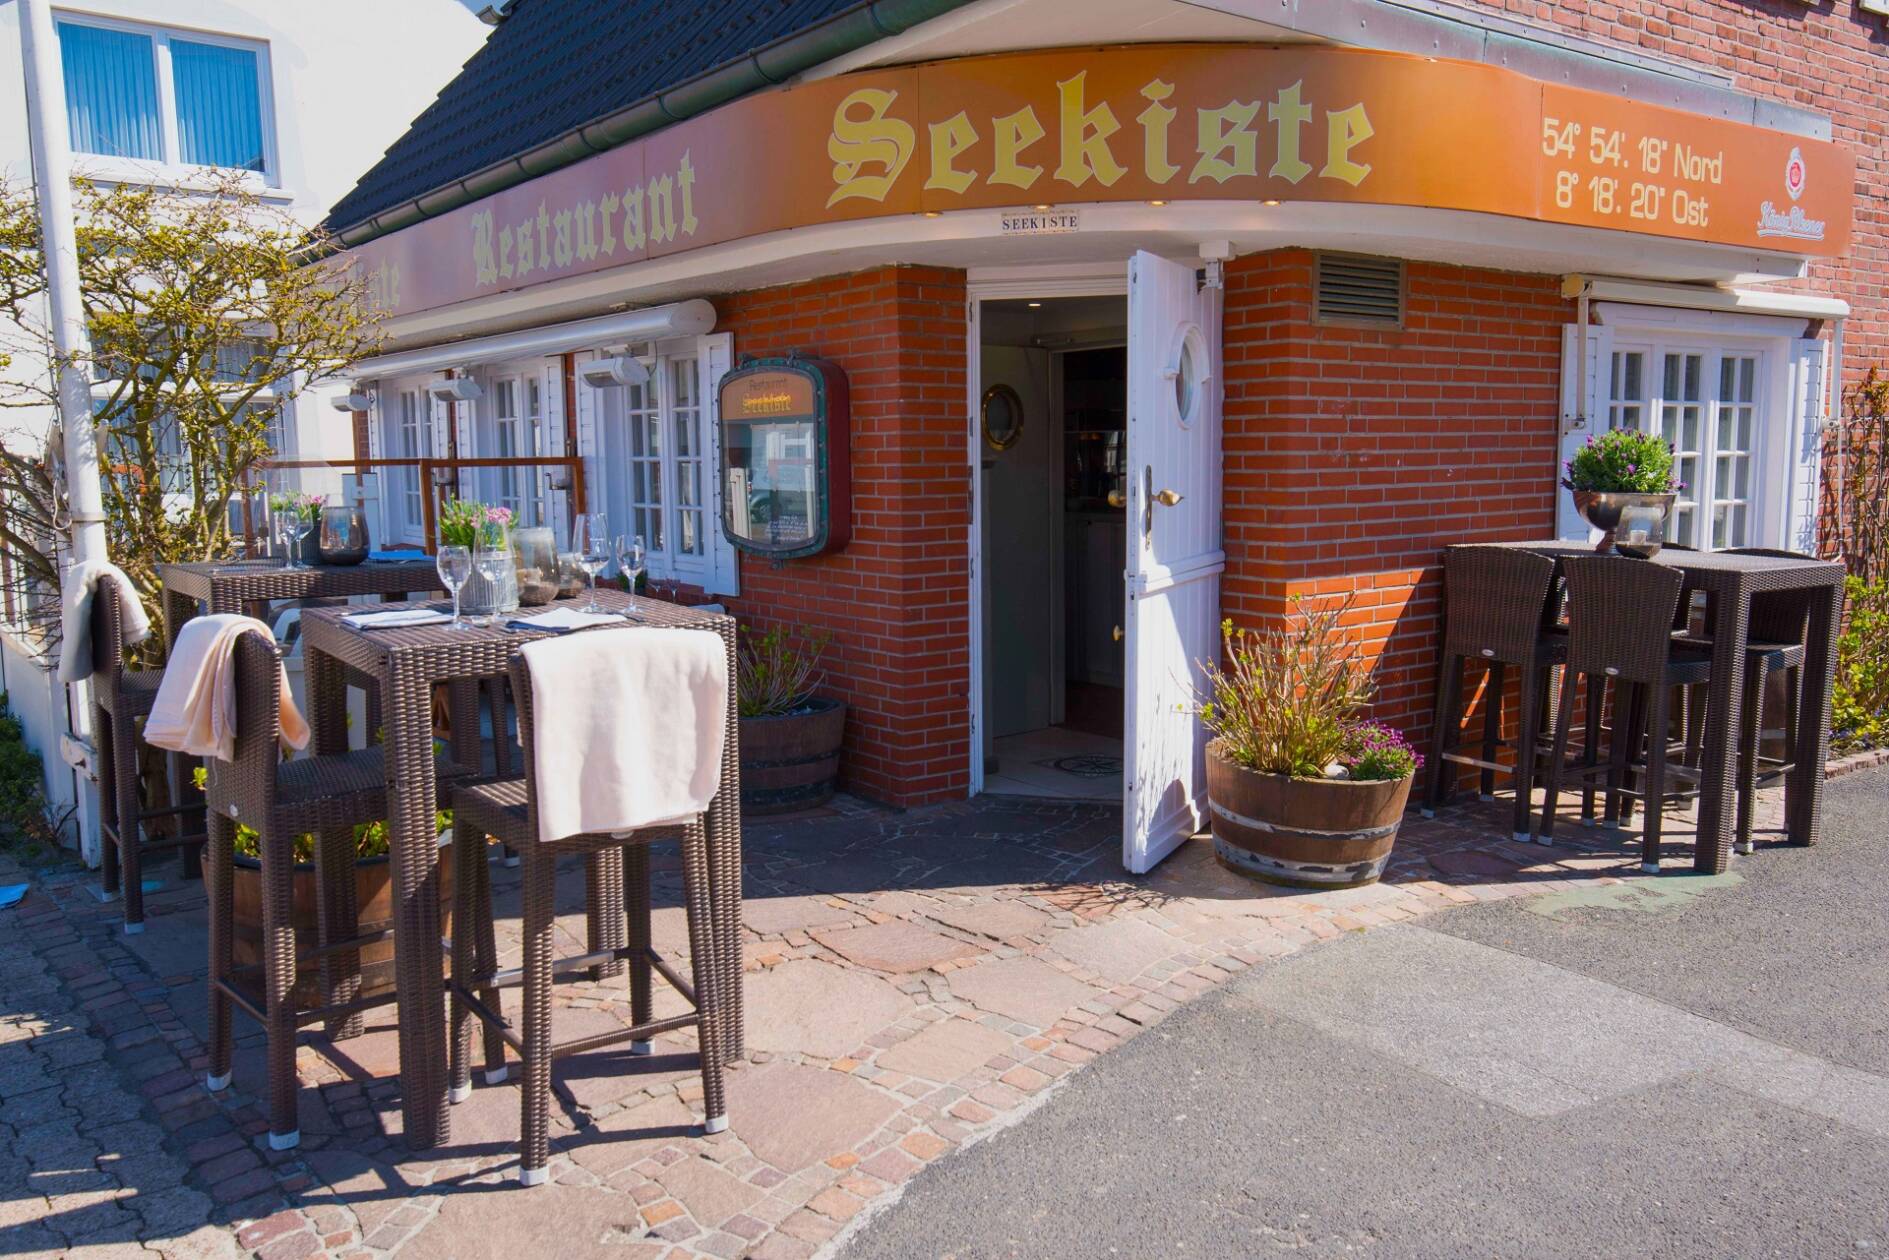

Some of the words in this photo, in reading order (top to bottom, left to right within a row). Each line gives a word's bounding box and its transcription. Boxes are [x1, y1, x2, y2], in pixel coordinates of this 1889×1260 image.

[826, 69, 1375, 209] Seekiste
[1542, 116, 1581, 160] 54°
[1674, 143, 1723, 185] Nord
[471, 148, 699, 288] Restaurant
[1002, 215, 1078, 230] SEEKISTE
[1556, 171, 1579, 208] 8°
[1672, 190, 1709, 228] Ost
